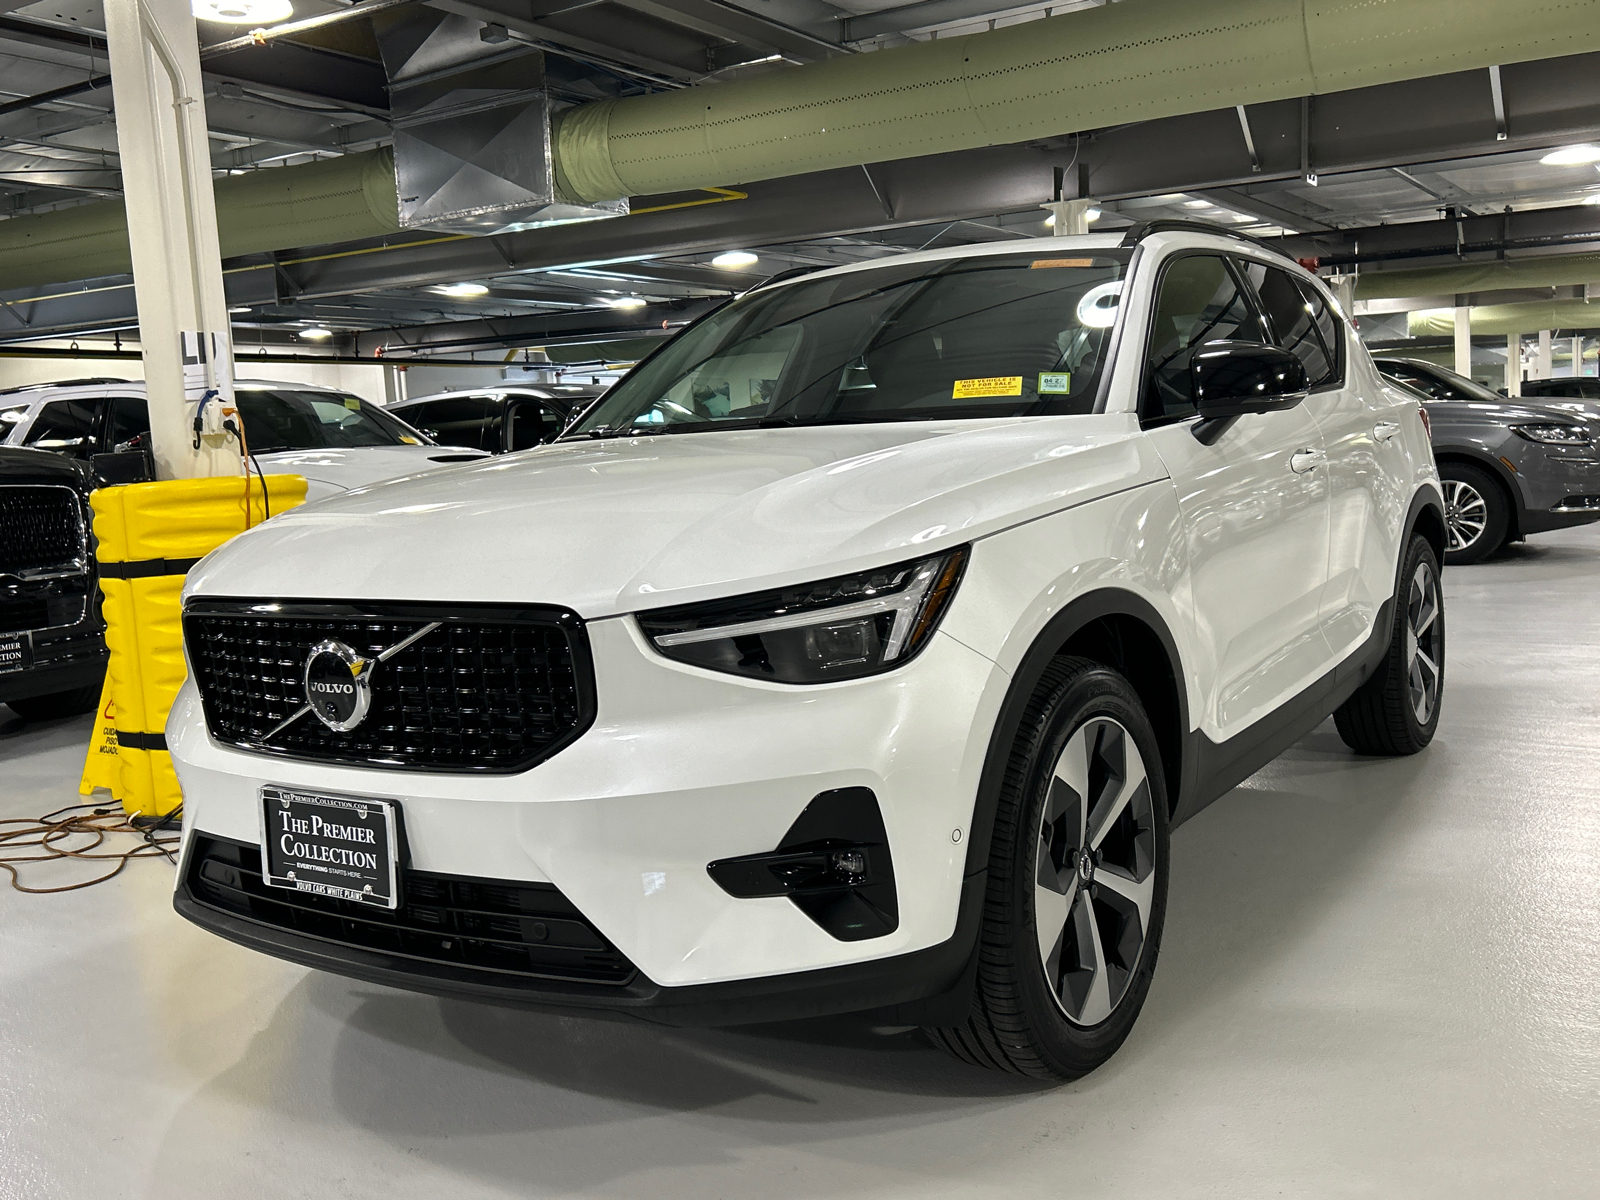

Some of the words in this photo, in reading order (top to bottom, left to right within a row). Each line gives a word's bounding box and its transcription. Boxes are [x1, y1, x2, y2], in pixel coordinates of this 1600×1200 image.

[309, 682, 354, 694] VOLVO
[106, 736, 118, 745] PISO
[311, 815, 376, 844] PREMIER
[281, 834, 377, 870] COLLECTION
[296, 862, 328, 873] EVERYTHING
[328, 867, 347, 877] STARTS
[296, 881, 311, 891] VOLVO
[312, 884, 326, 894] CARS
[326, 886, 344, 897] WHITE
[344, 890, 363, 901] PLAINS
